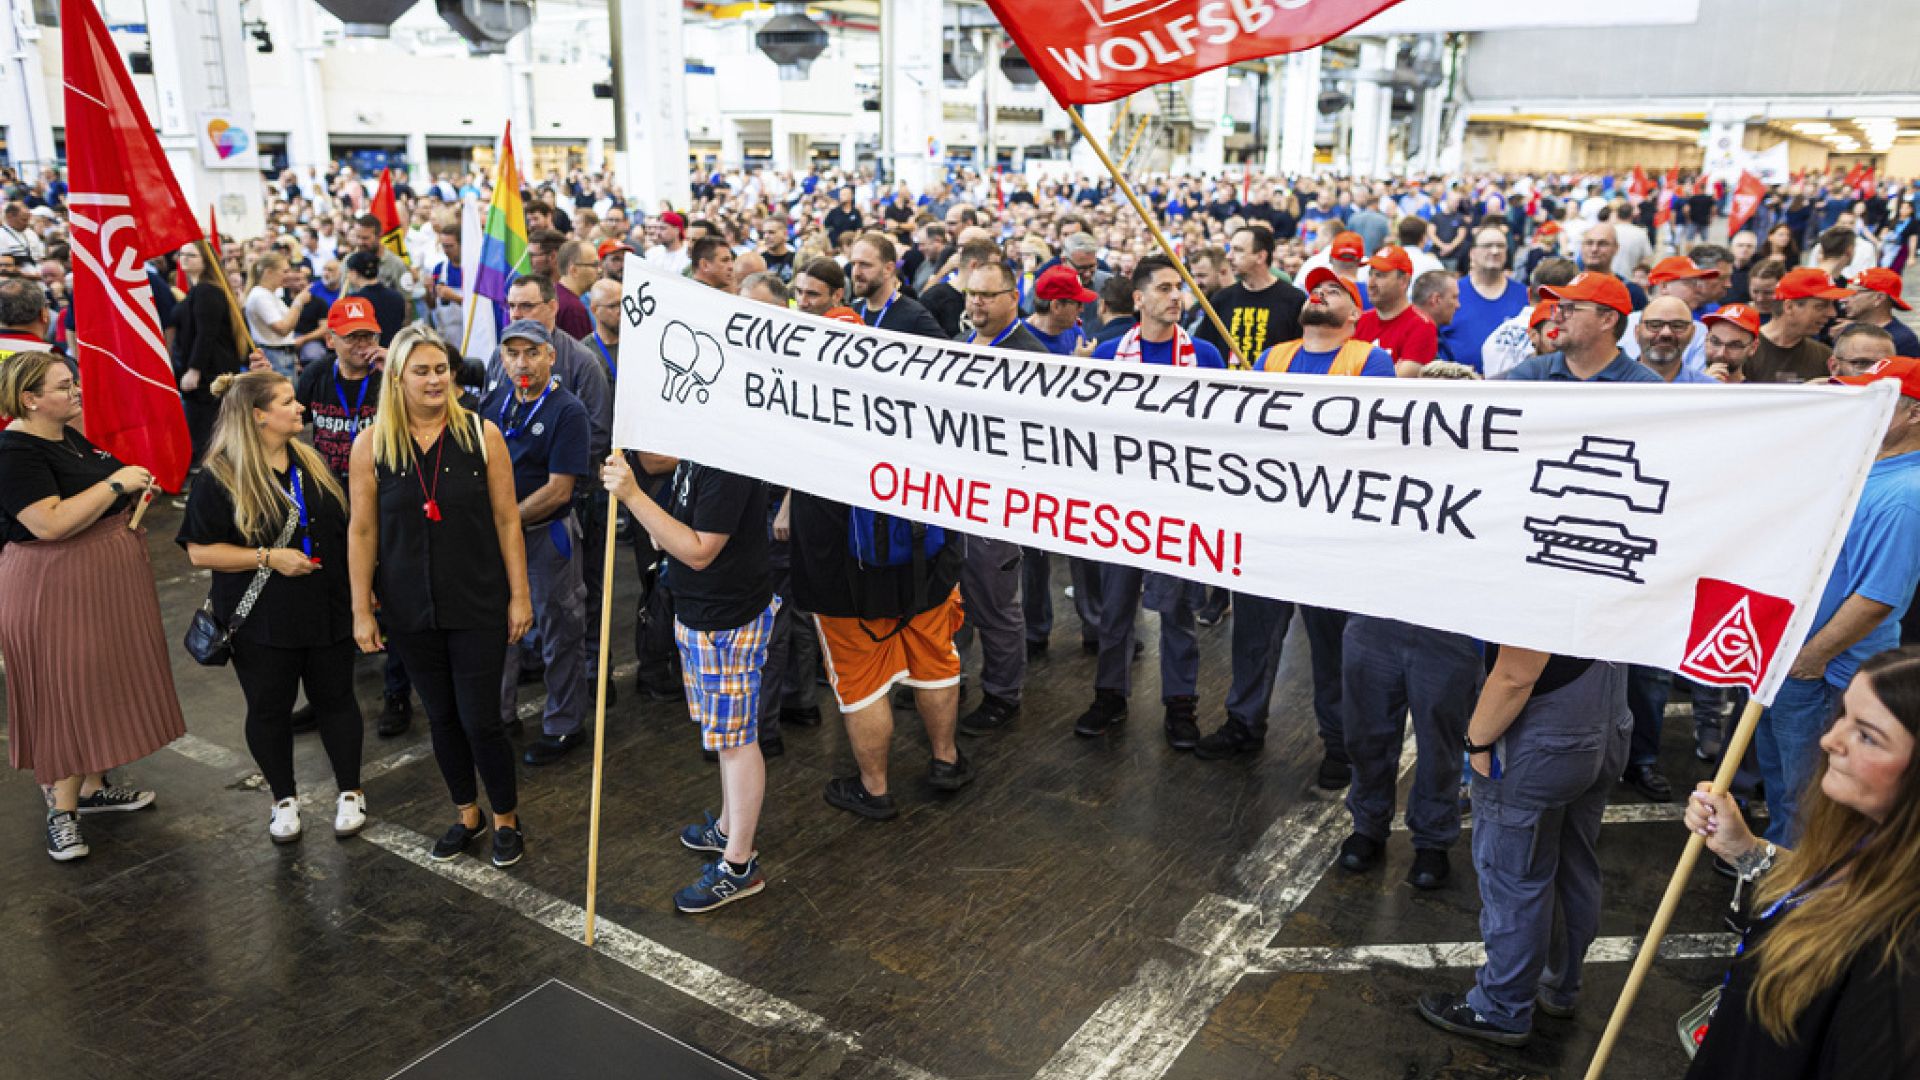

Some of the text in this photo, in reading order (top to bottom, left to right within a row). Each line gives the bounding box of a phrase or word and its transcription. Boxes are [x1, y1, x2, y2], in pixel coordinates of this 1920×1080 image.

[1048, 0, 1312, 82] WOLFSB
[622, 281, 656, 327] B6
[725, 312, 817, 357] EINE
[817, 328, 1304, 432] TISCHTENNISPLATTE
[1311, 396, 1523, 452] OHNE
[744, 367, 1483, 540] BÄLLE IST WIE EIN PRESSWERK
[869, 460, 1242, 577] OHNE PRESSEN!
